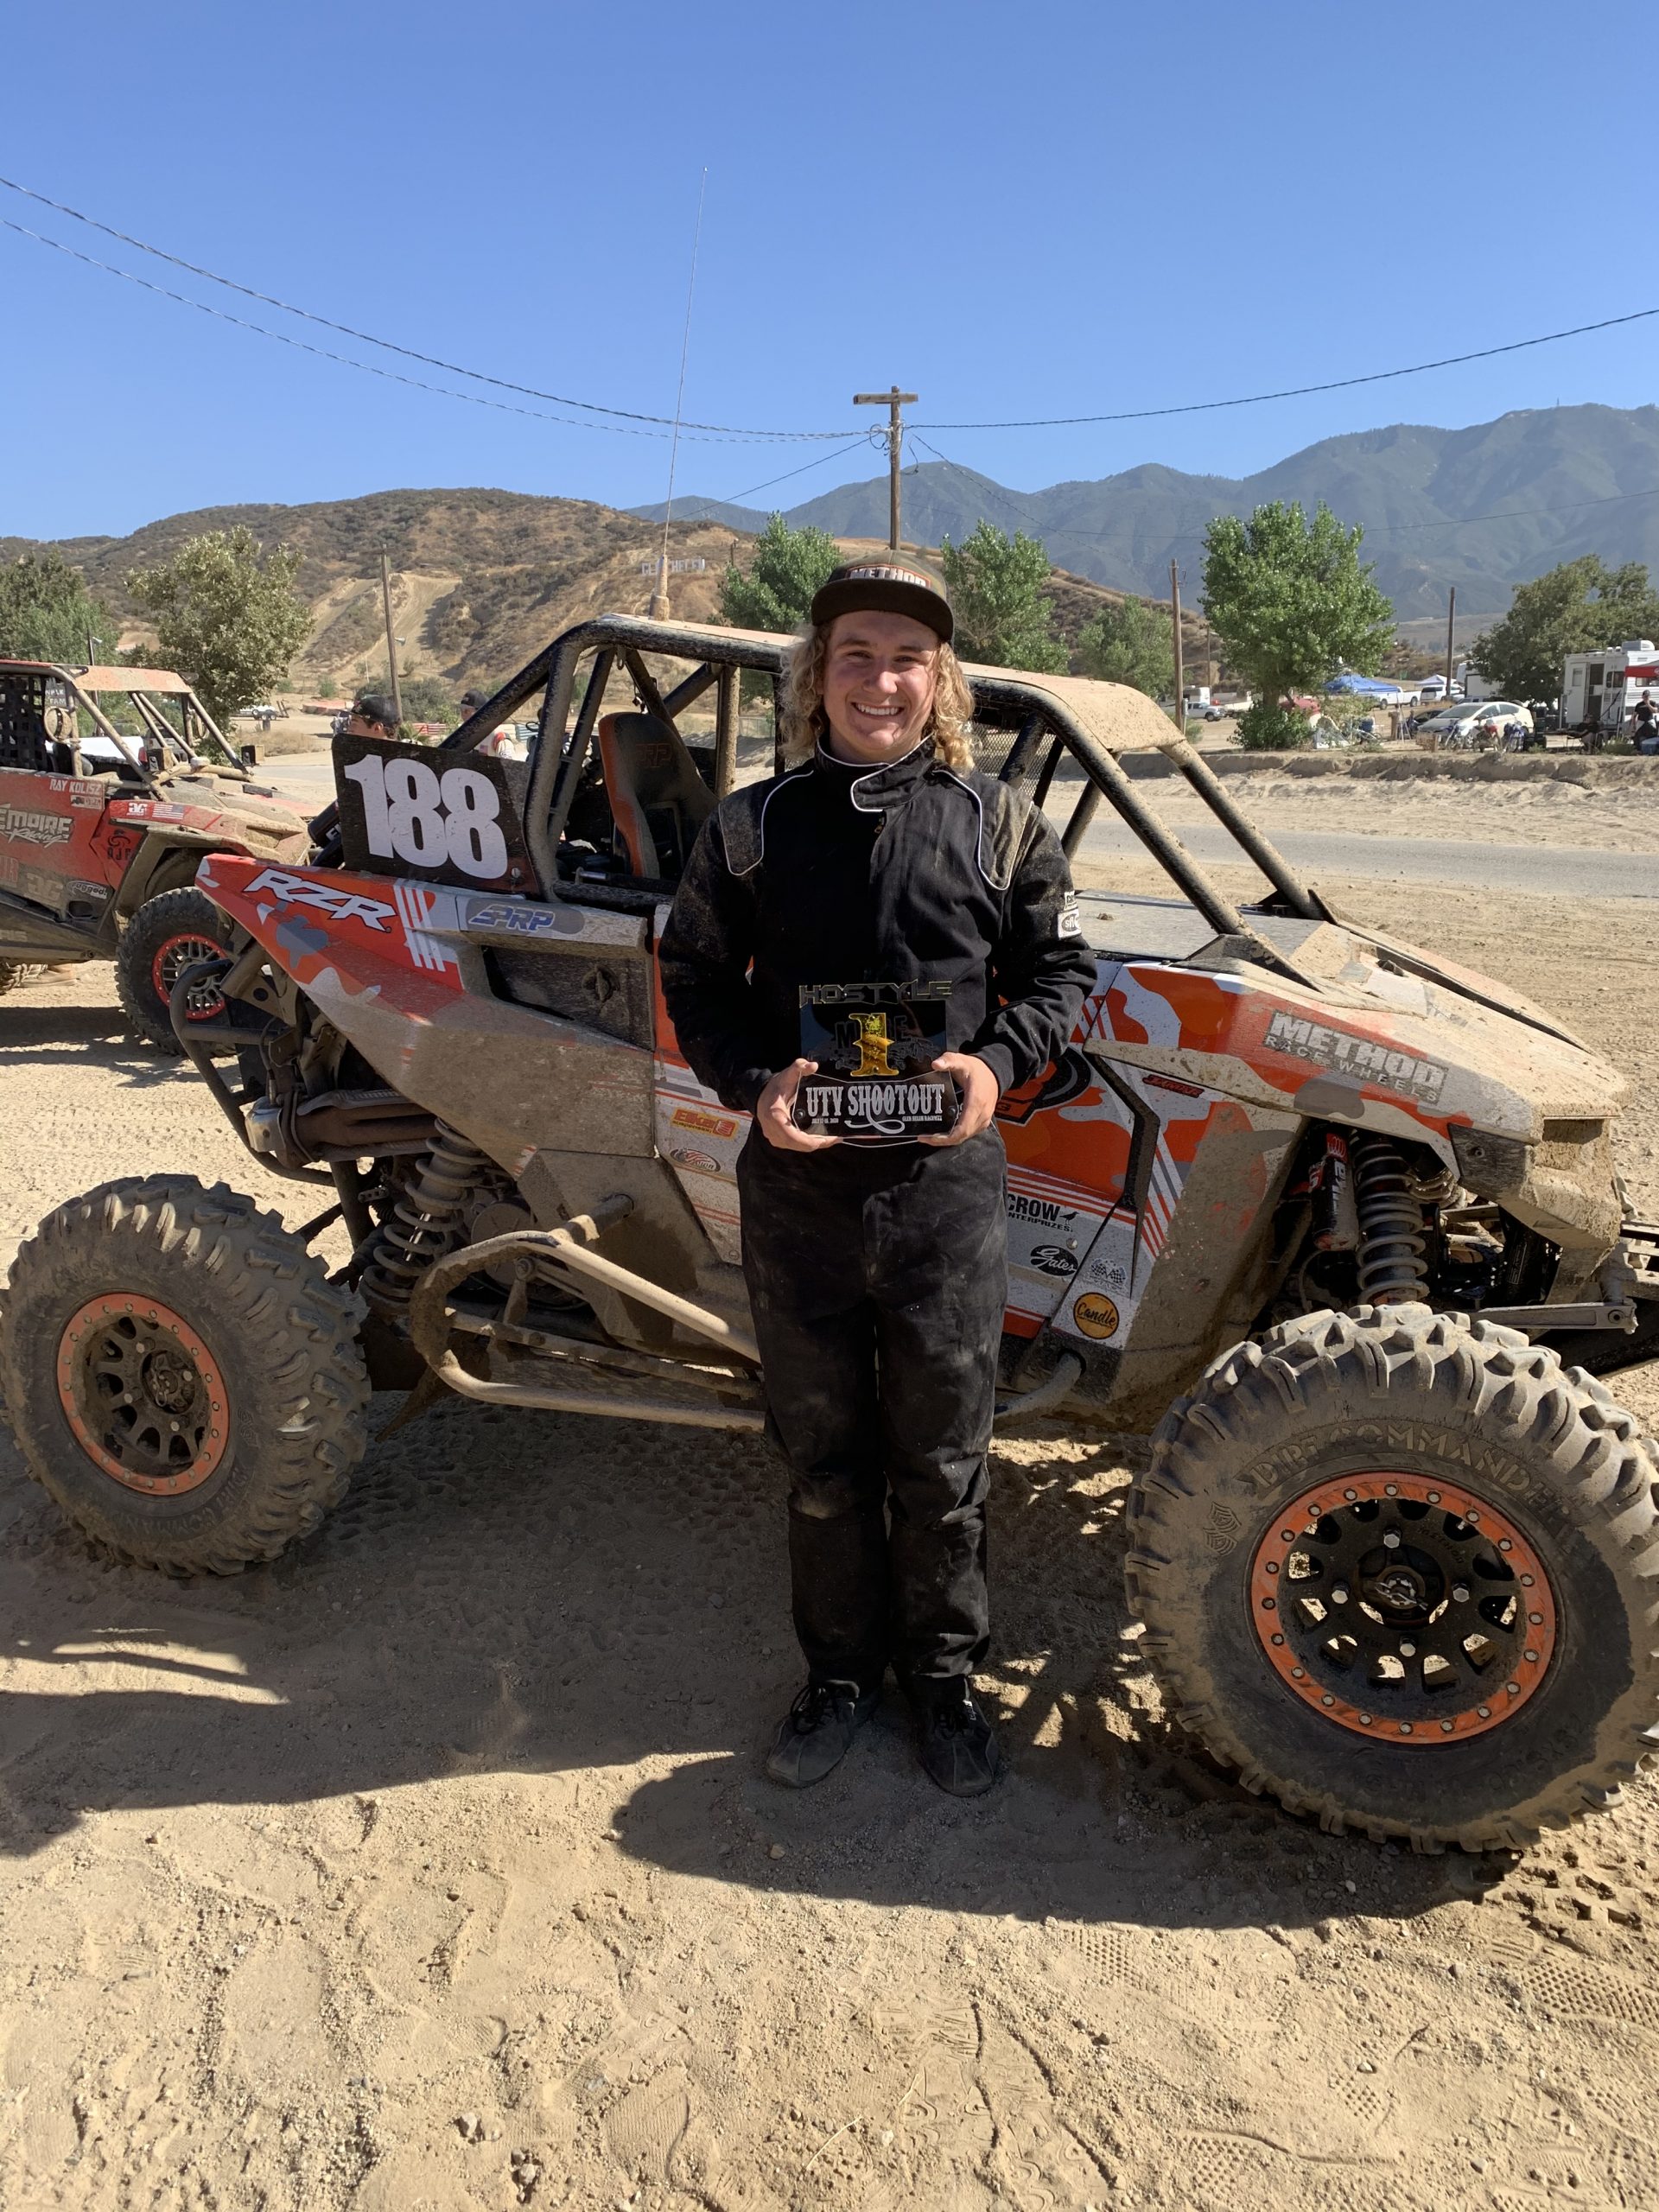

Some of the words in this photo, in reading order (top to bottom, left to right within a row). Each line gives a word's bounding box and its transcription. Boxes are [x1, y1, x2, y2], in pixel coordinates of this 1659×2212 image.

[49, 779, 68, 791] RAY
[344, 753, 508, 880] 188
[243, 867, 397, 933] RZR
[799, 979, 952, 1008] HOSTYLE
[849, 1012, 899, 1077] 1
[1265, 1035, 1325, 1064] RACE
[1338, 1060, 1438, 1102] WHEELS
[1270, 1012, 1446, 1090] METHOD
[805, 1086, 844, 1116] UTV
[844, 1084, 945, 1135] SHOOTOUT
[1007, 1193, 1061, 1222] CROW
[1031, 1248, 1077, 1271] Gates
[1077, 1302, 1116, 1326] Candle
[1249, 1434, 1321, 1489] DIRT
